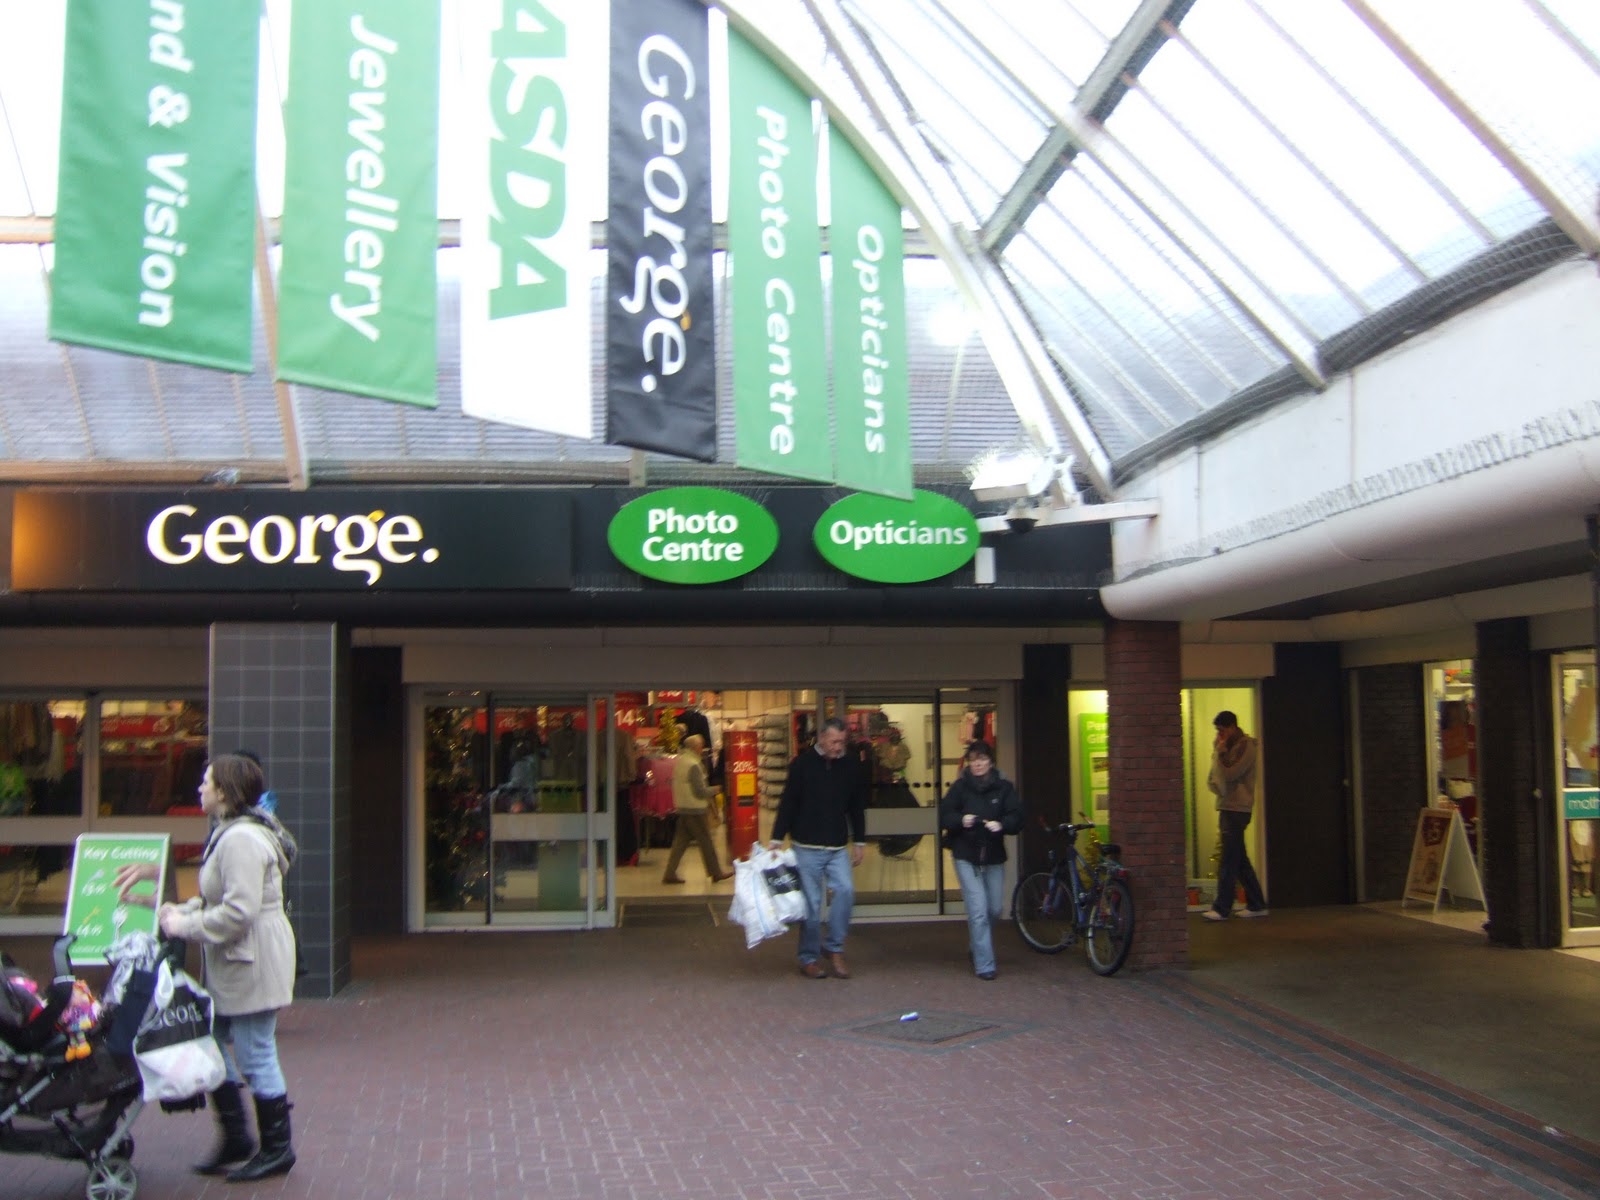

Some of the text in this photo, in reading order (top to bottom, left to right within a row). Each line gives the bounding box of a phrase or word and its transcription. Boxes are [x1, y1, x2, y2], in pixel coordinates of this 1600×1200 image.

[149, 85, 189, 127] &
[330, 14, 400, 341] Jewellery
[489, 0, 567, 320] ASDA
[138, 153, 189, 327] Vision
[619, 34, 696, 393] George.
[755, 105, 797, 455] Photo Centre
[852, 224, 889, 453] Opticians
[147, 504, 439, 586] George.
[642, 536, 744, 562] Centre
[648, 507, 739, 534] Photo
[830, 519, 968, 550] Opticians
